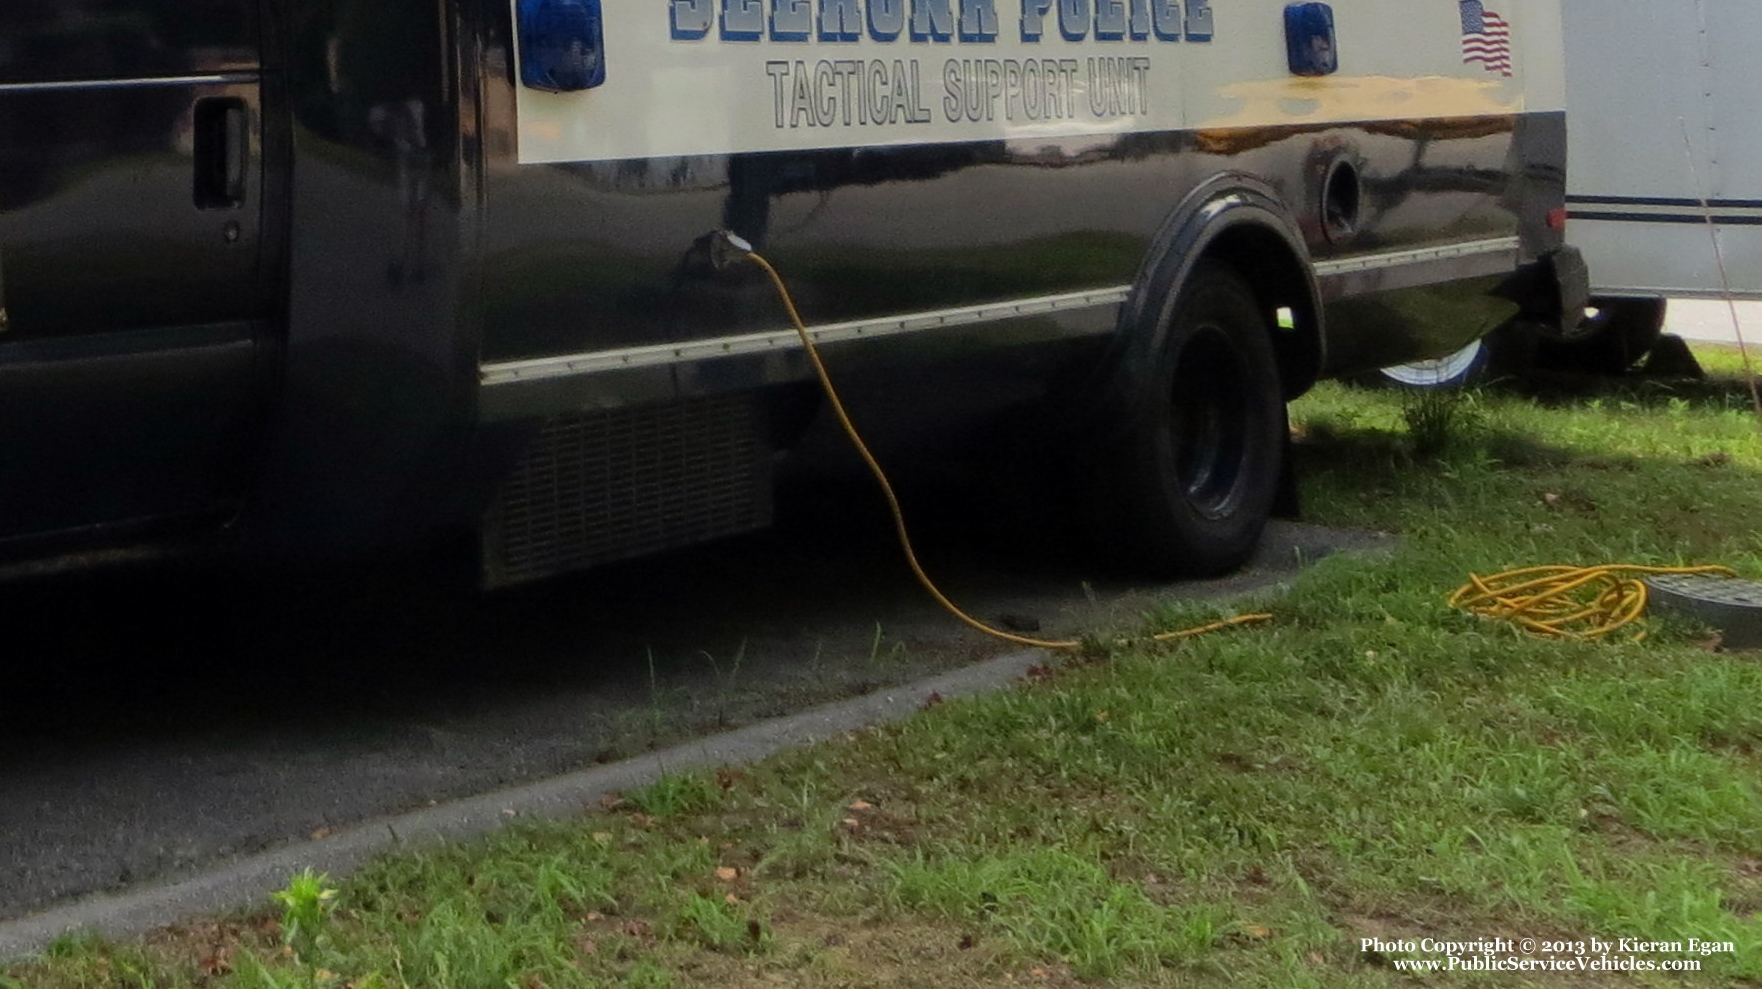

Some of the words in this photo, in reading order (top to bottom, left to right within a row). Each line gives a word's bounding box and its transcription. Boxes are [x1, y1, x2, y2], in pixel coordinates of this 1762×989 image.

[765, 59, 932, 128] TACTICAL
[942, 58, 1078, 123] SUPPORT
[1088, 57, 1151, 117] UNIT
